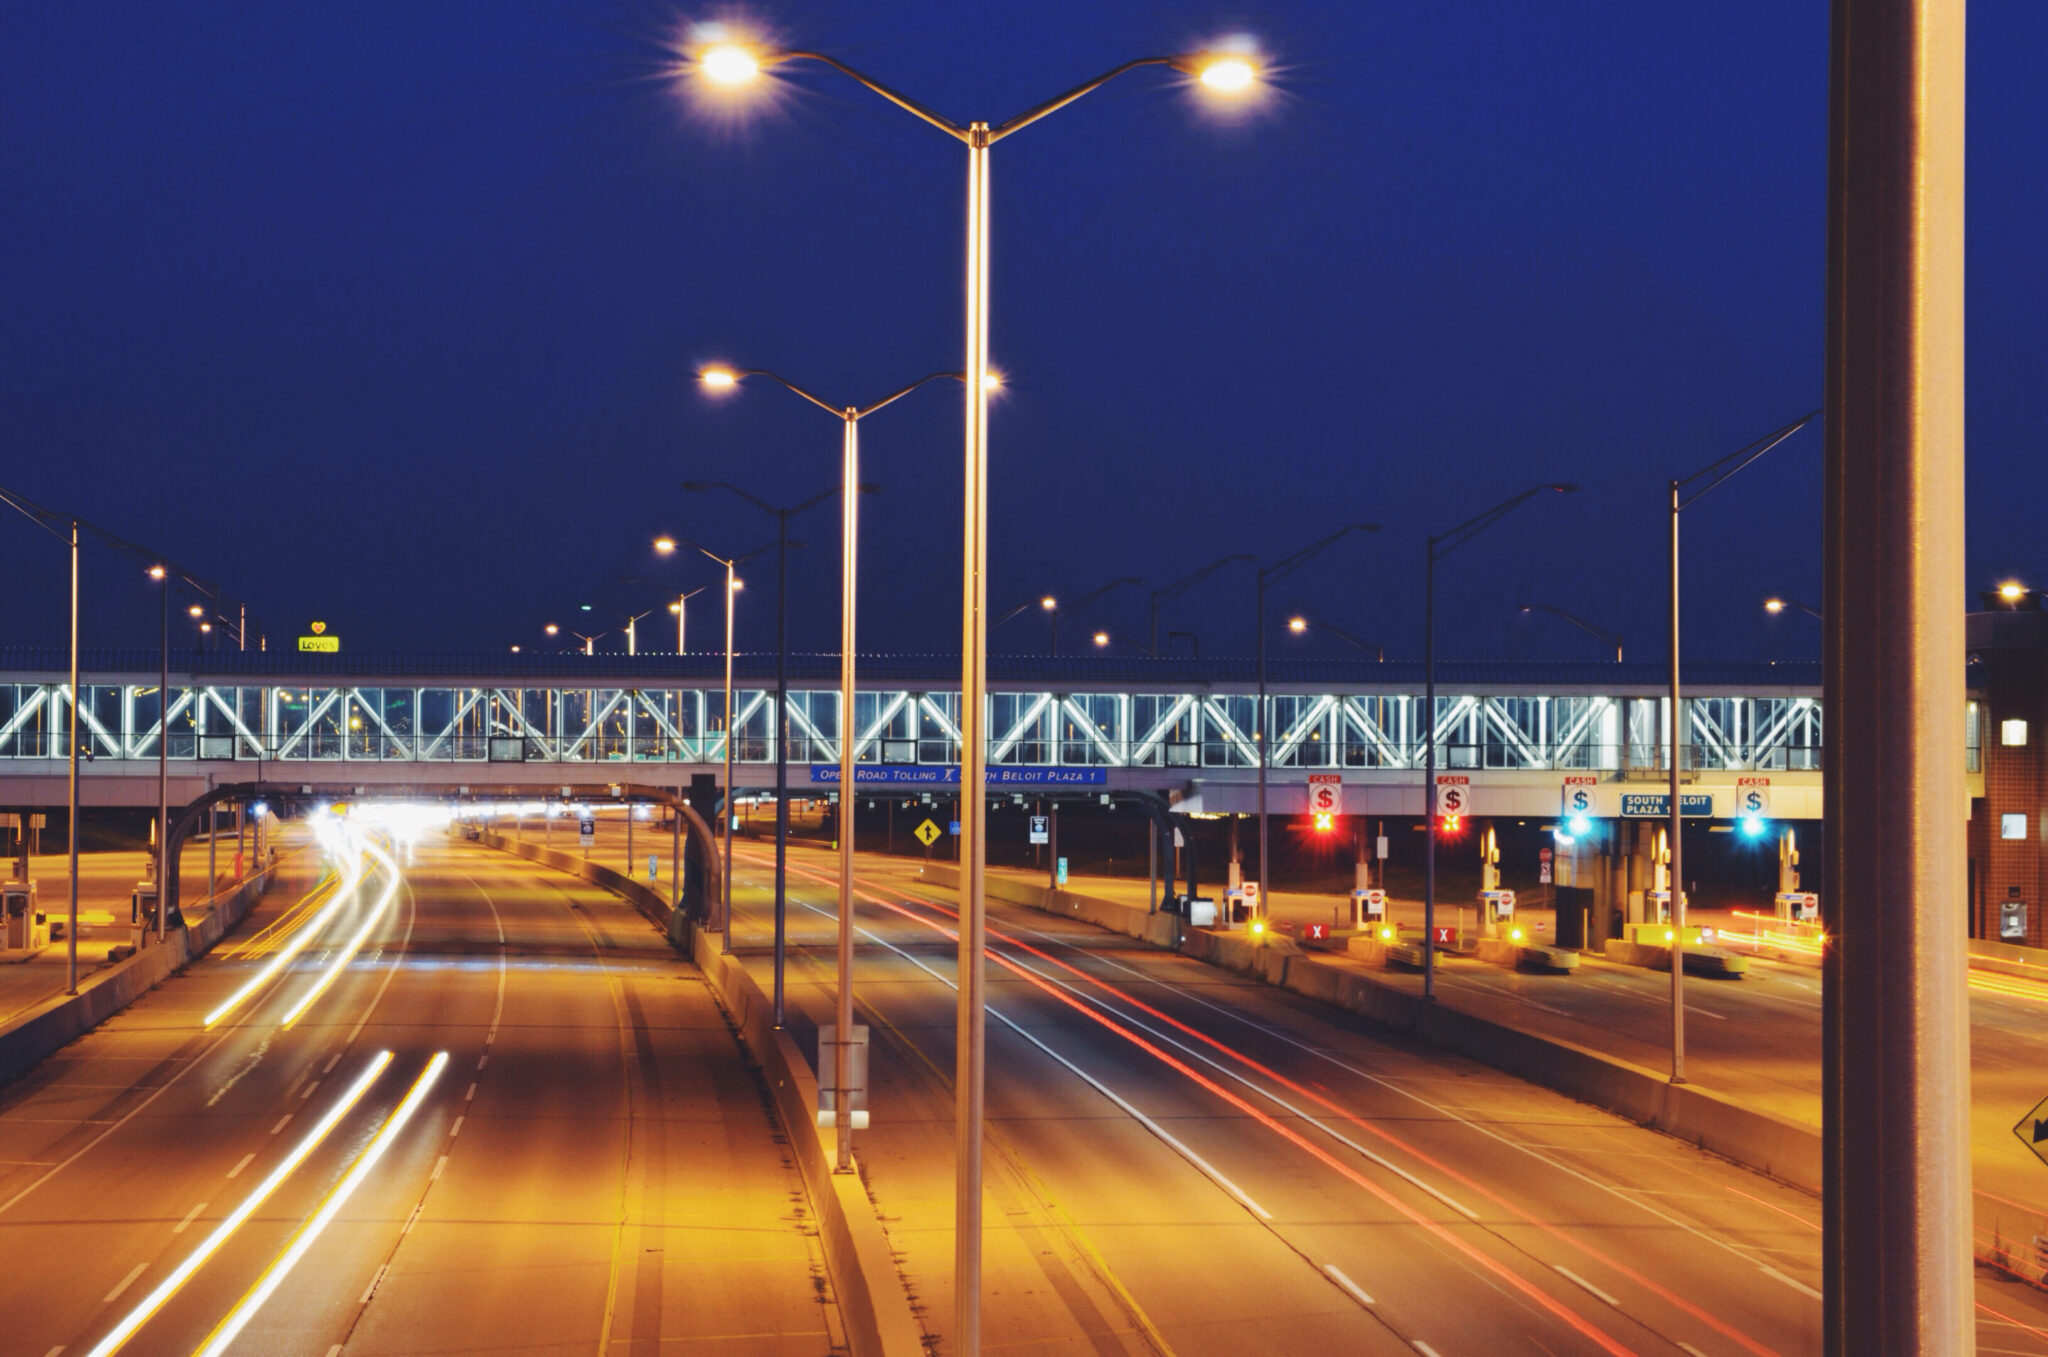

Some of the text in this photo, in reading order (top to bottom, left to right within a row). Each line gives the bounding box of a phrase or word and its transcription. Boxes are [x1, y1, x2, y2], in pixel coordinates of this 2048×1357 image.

[820, 769, 936, 780] OPE ROAD TOLLING
[1002, 771, 1042, 780] BELOIT
[1048, 771, 1083, 780] PLAZA
[1090, 772, 1095, 780] 1
[1313, 775, 1337, 783] CASH
[1441, 776, 1465, 784] CASH
[1570, 777, 1592, 785] CASH
[1743, 778, 1765, 786] CASH
[1627, 796, 1707, 805] SOUTH ELOIT
[1627, 805, 1660, 814] PLAZA
